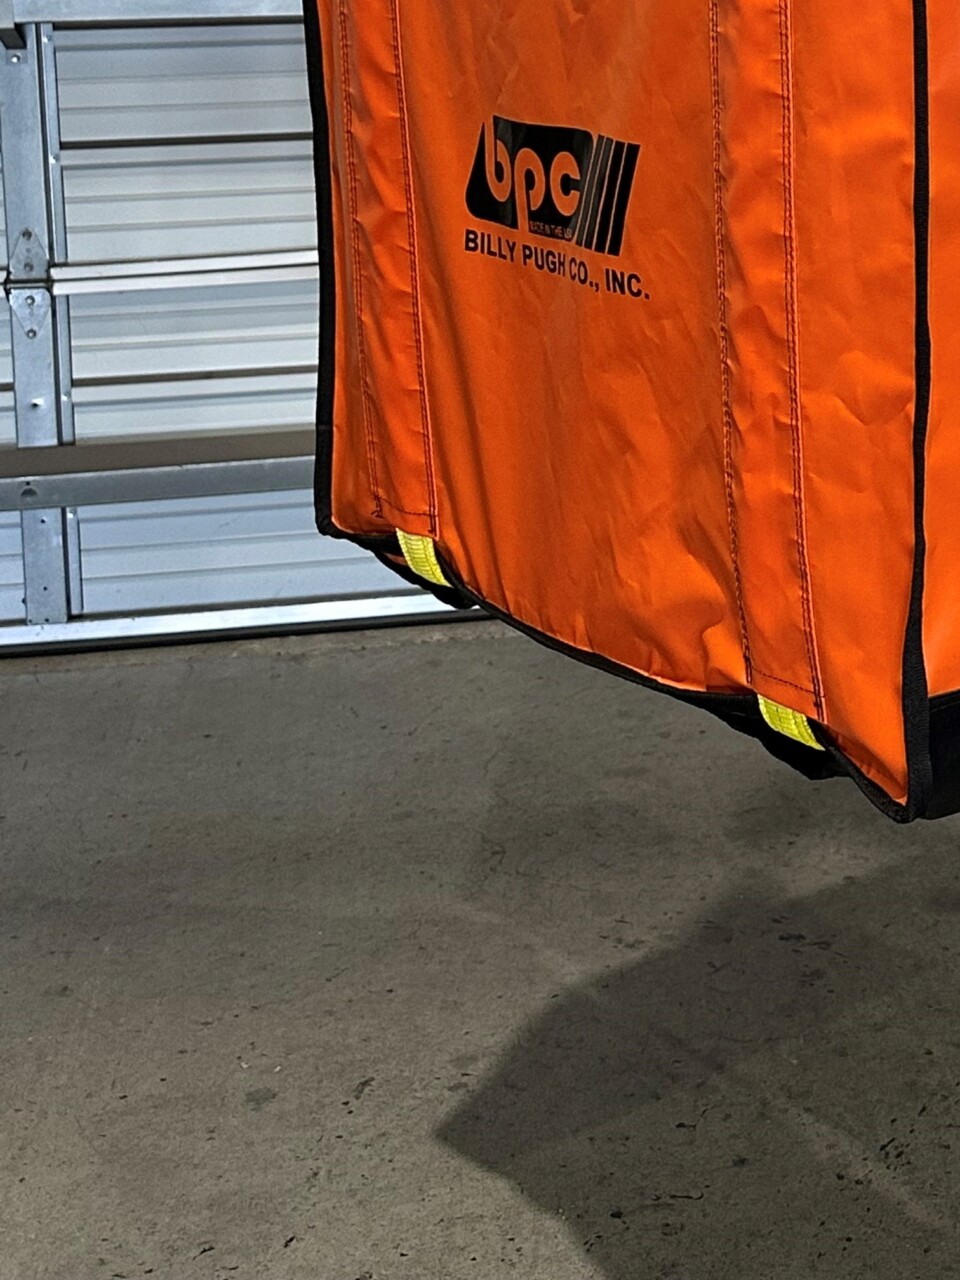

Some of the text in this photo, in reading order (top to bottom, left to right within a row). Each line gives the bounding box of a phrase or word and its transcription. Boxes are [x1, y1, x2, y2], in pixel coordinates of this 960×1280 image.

[465, 229, 650, 300] BILLY PUGH CO., INC.
